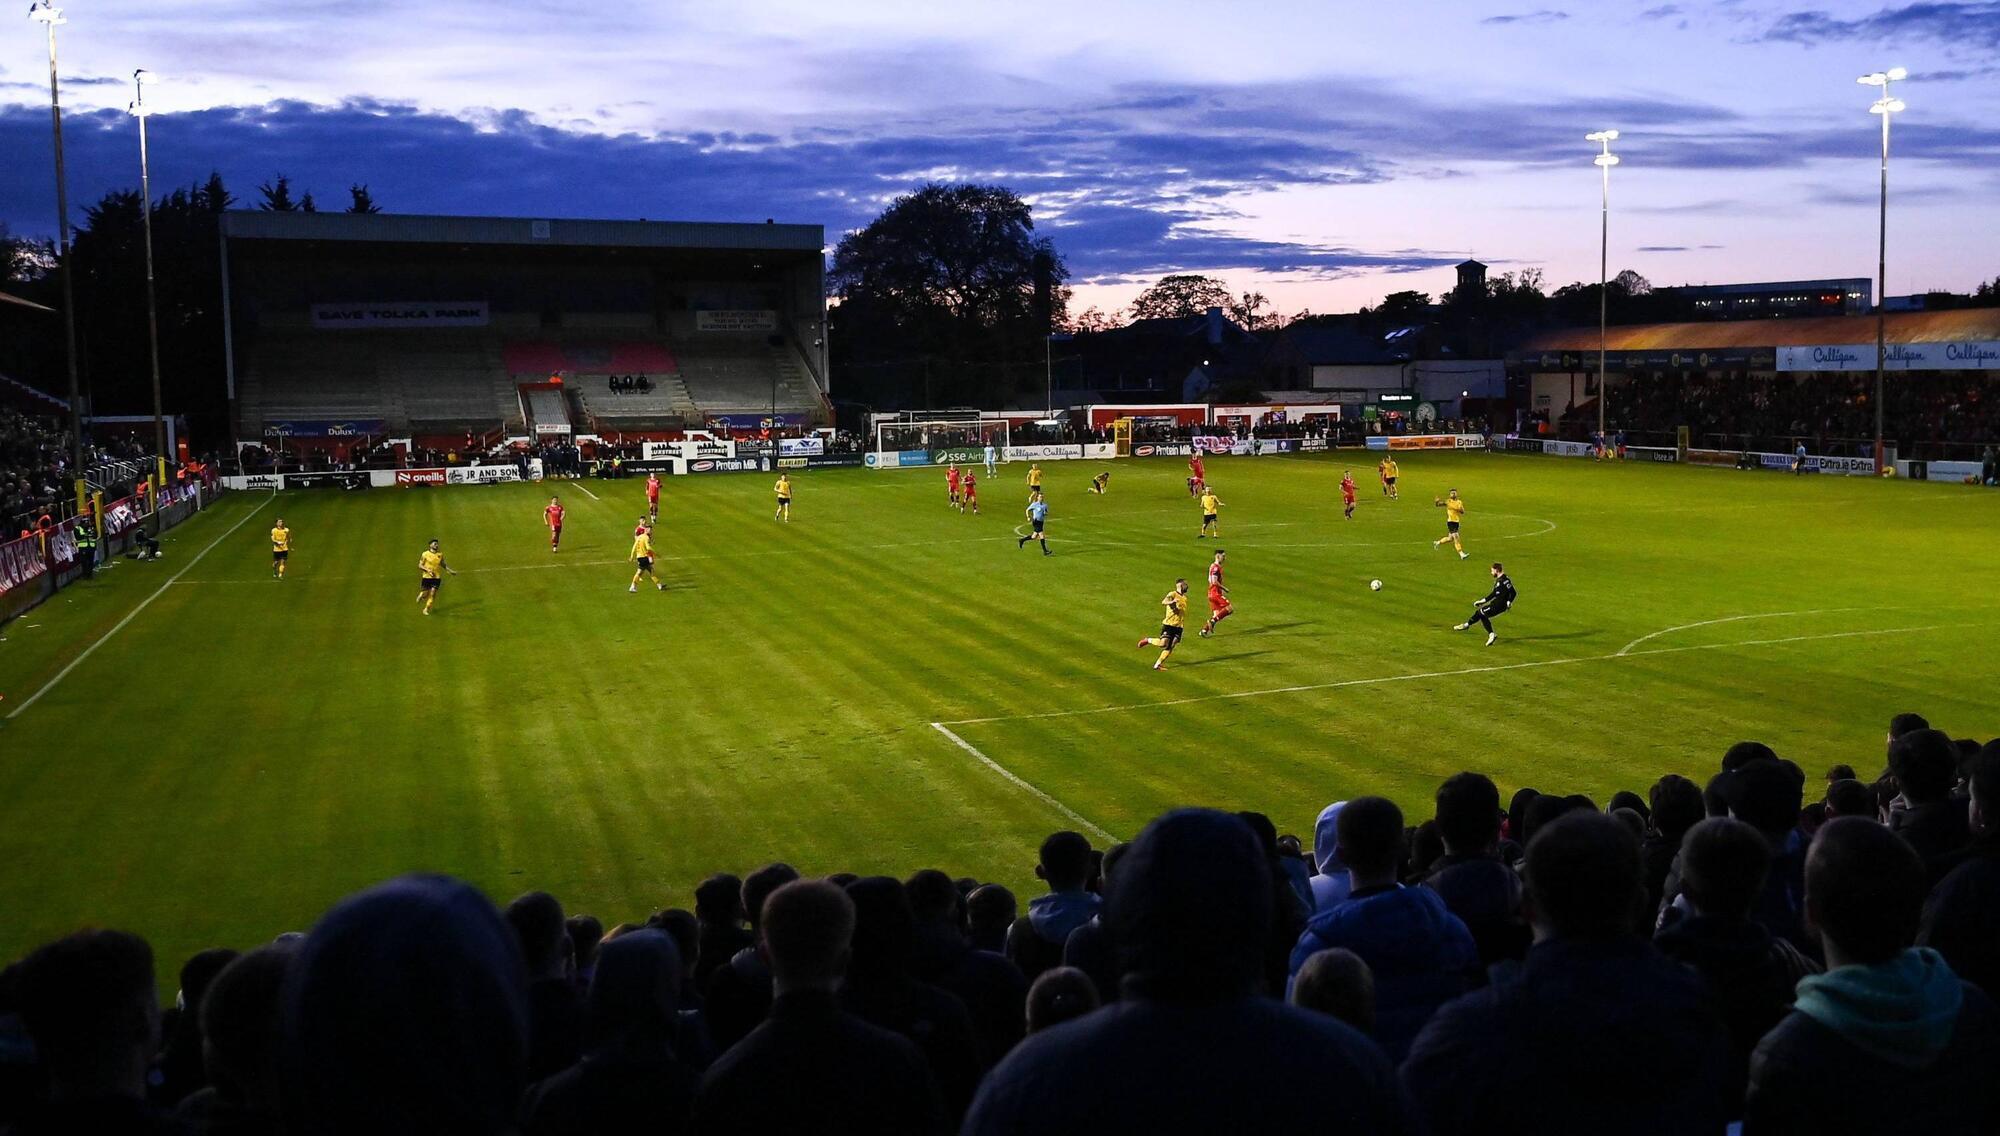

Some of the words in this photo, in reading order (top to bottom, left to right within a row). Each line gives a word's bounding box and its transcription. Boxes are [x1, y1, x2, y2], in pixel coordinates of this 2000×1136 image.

[318, 310, 364, 320] SAVE
[368, 310, 429, 319] TOLKA
[434, 309, 481, 318] PARK
[1813, 347, 1858, 368] Culligan
[1946, 344, 1999, 367] Culligan
[328, 427, 354, 436] Dulux
[948, 451, 966, 462] sse
[1002, 446, 1040, 459] Culligan
[1043, 446, 1080, 459] Culligan
[1155, 446, 1179, 457] Protein
[1179, 445, 1192, 456] Milk
[715, 460, 742, 471] Protein
[743, 460, 758, 470] Milk
[1820, 459, 1849, 470] Extra.ie
[412, 473, 445, 483] oneills
[466, 470, 476, 480] JR
[479, 469, 497, 477] AND
[500, 468, 518, 477] SON
